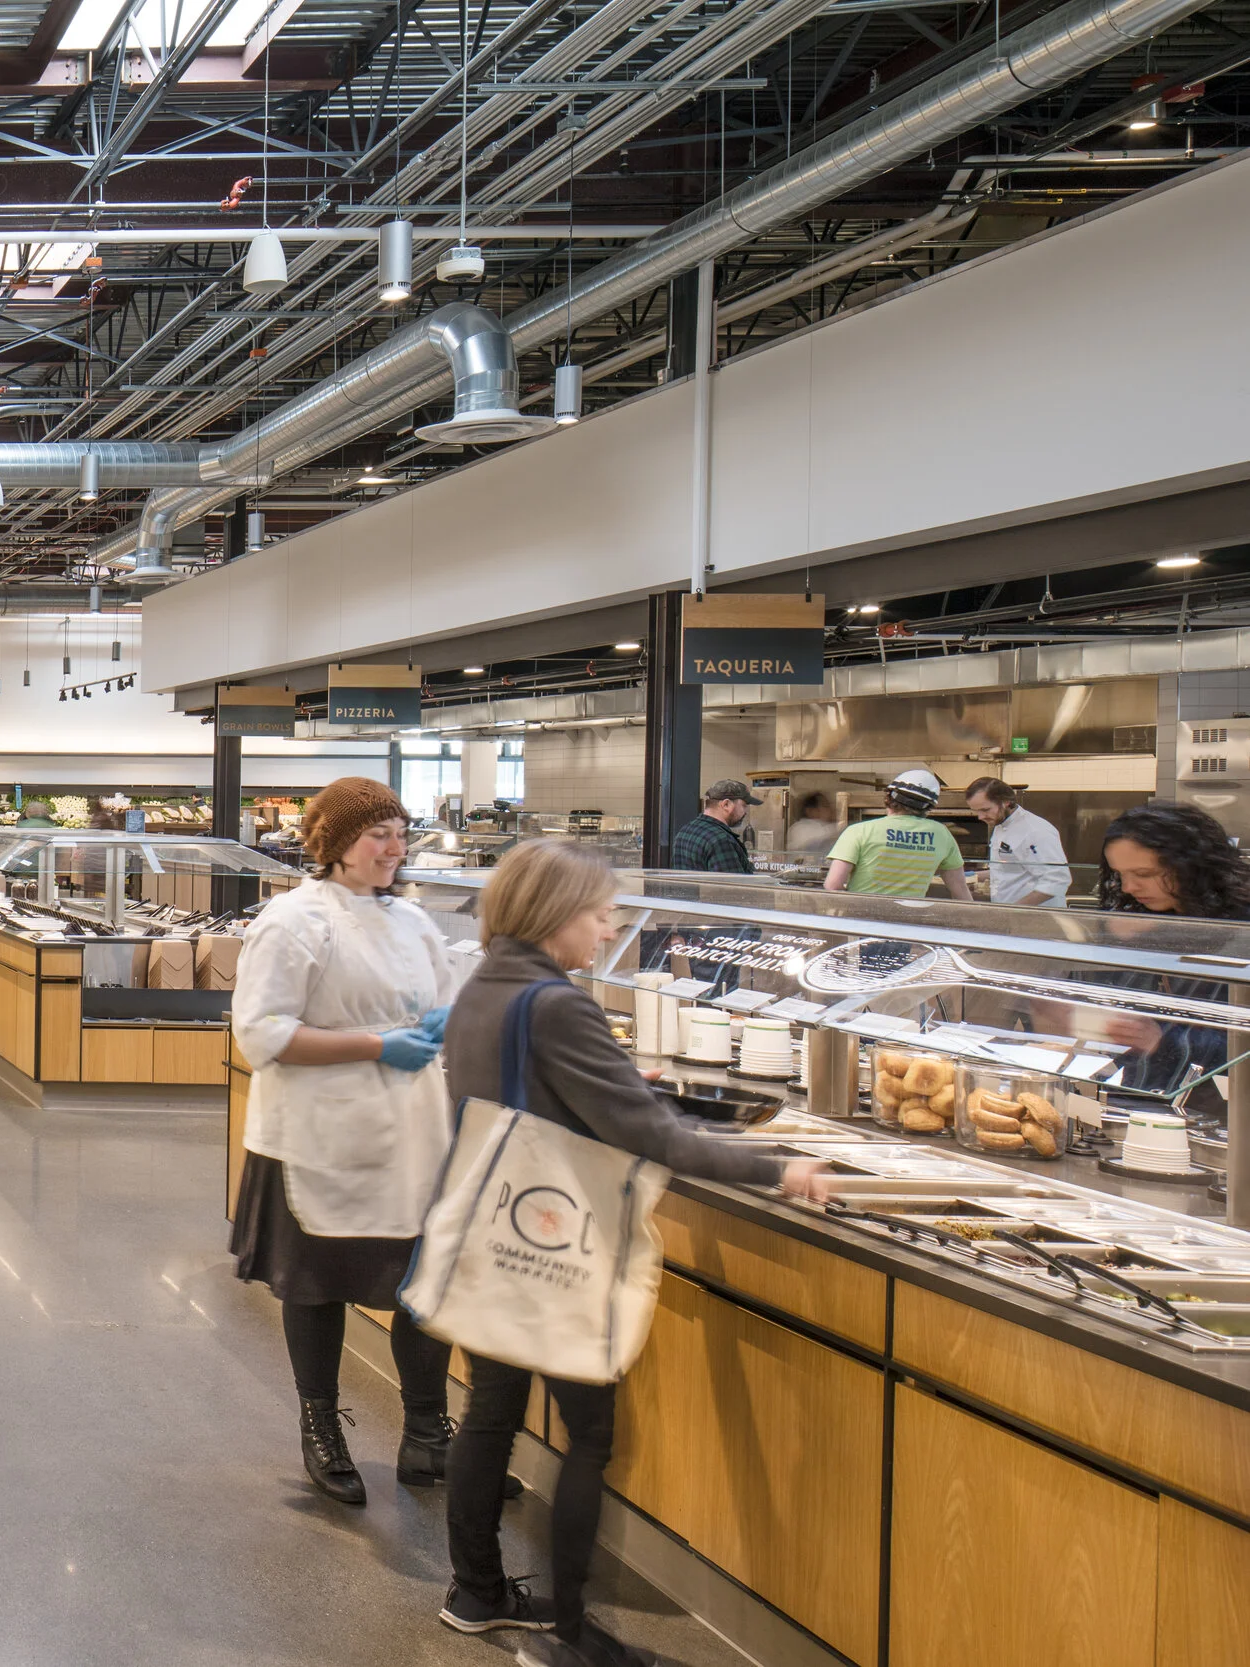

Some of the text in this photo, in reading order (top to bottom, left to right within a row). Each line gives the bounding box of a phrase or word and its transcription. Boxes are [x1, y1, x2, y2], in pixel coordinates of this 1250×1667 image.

[693, 658, 795, 677] TAQUERIA
[335, 707, 396, 718] PIZZERIA
[222, 722, 291, 732] GRAIN BOWLS
[886, 828, 935, 845] SAFETY
[754, 862, 769, 871] OUR
[770, 862, 799, 872] KITCHEN
[706, 936, 811, 960] START FROM
[772, 934, 827, 947] OUR CHEFS
[665, 944, 741, 964] SCRATCH
[491, 1180, 596, 1256] PCC
